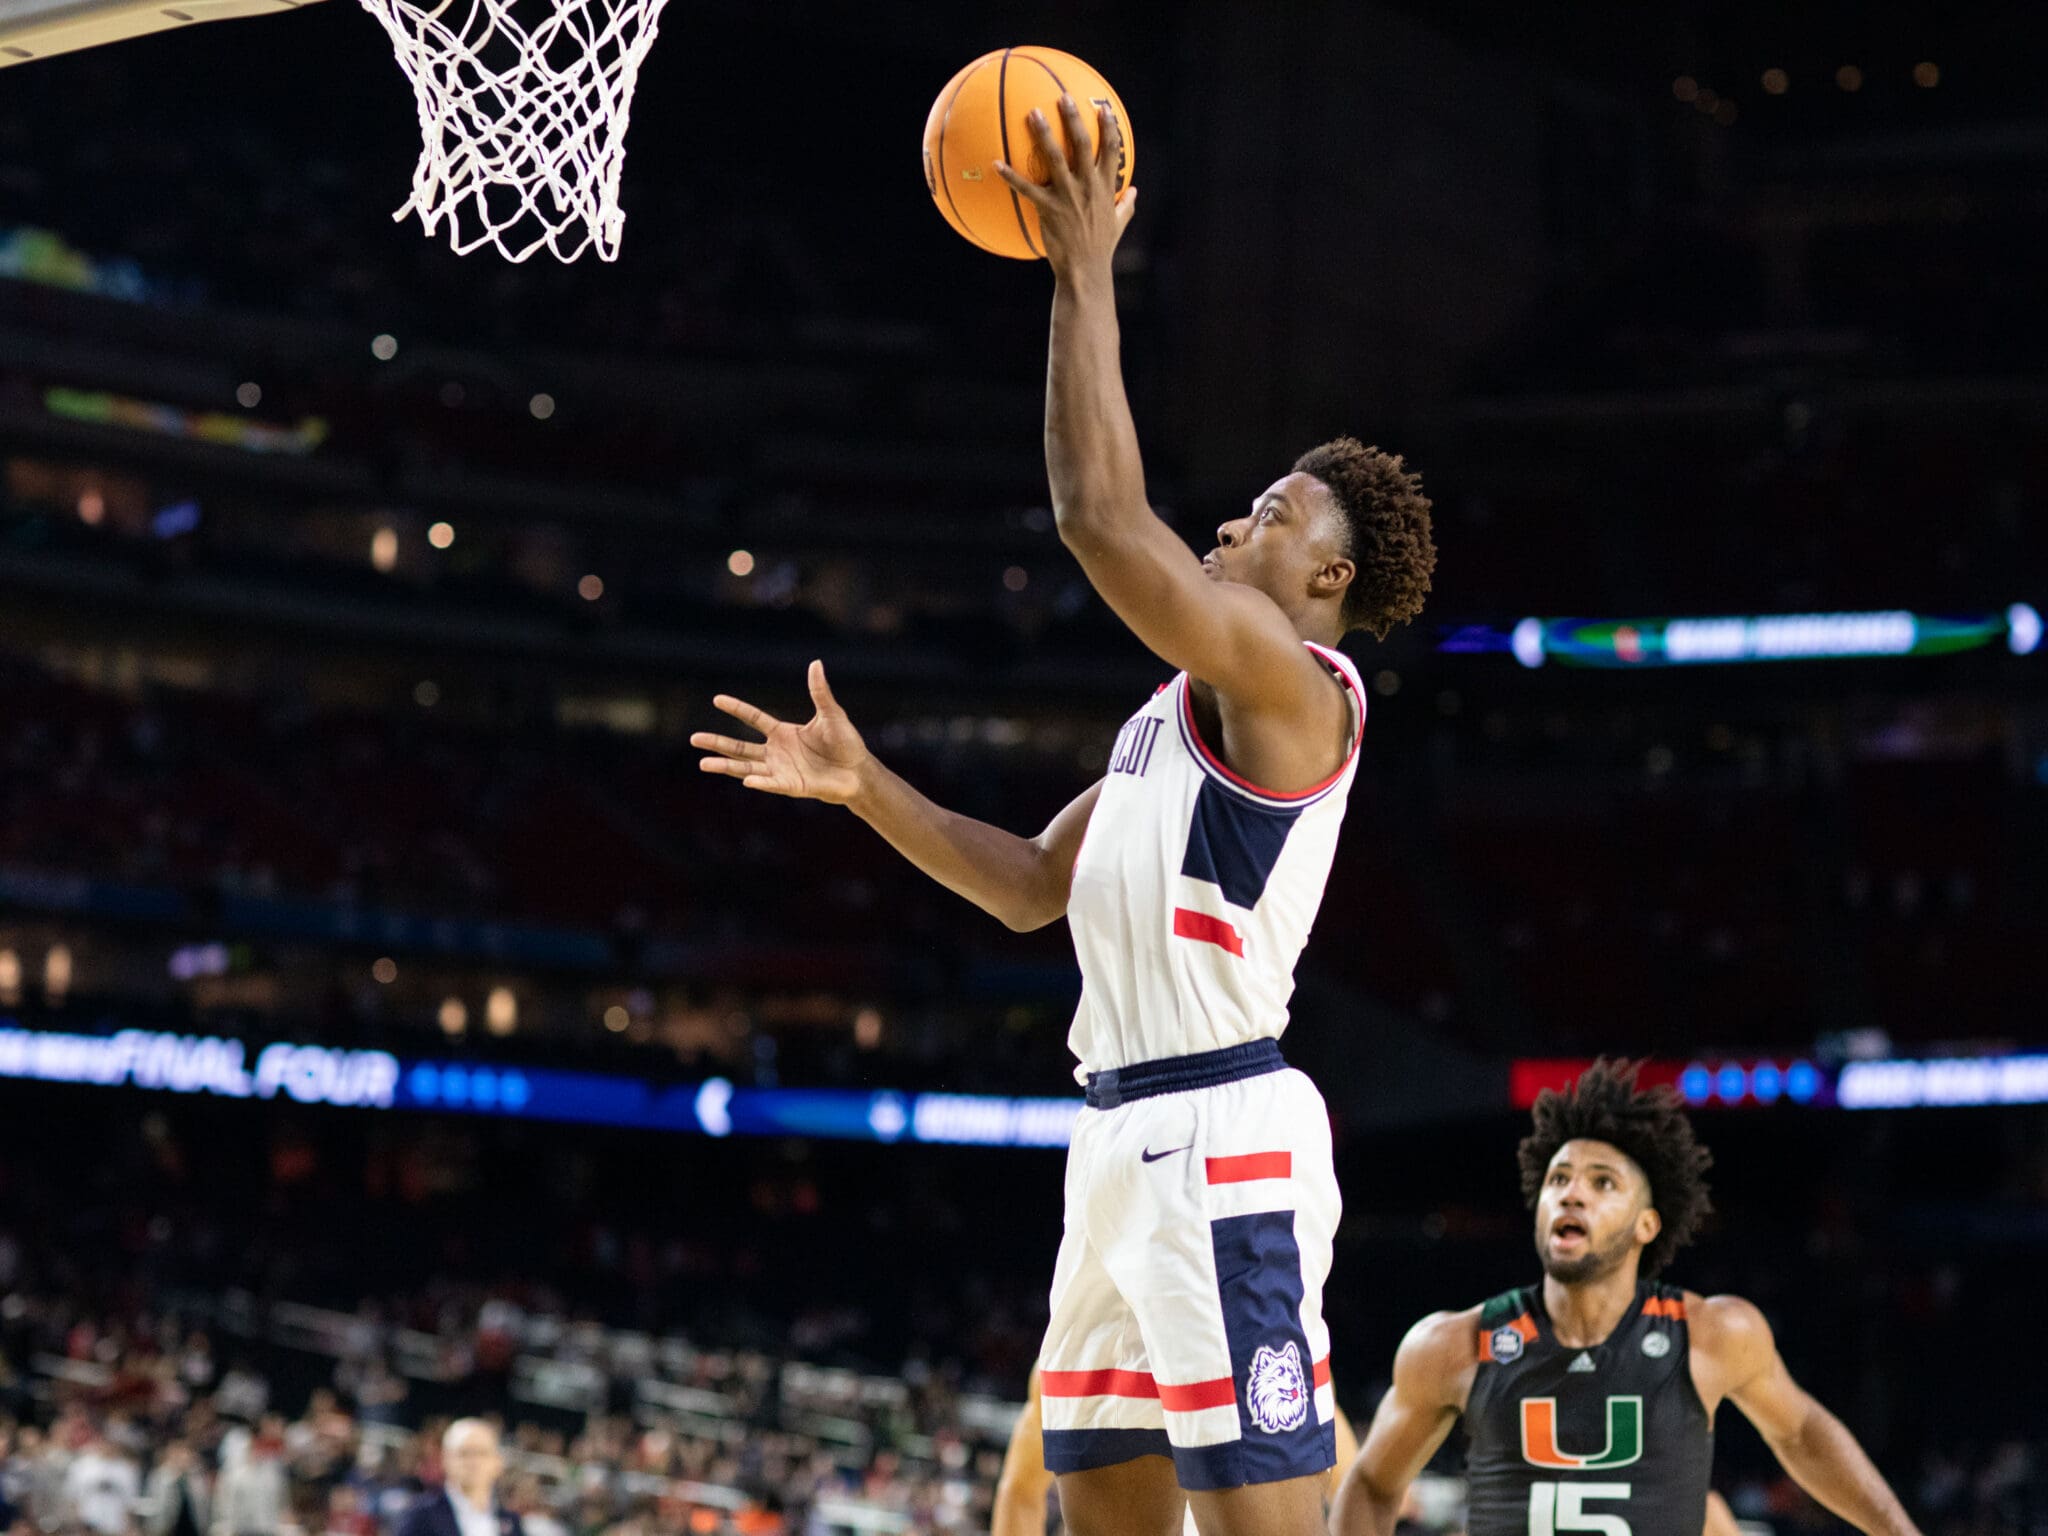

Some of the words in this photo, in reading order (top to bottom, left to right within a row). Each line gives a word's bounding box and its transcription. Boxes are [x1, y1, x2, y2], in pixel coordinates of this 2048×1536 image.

[110, 1028, 252, 1097] FINAL
[255, 1042, 399, 1108] FOUR
[1520, 1395, 1643, 1469] U
[1528, 1481, 1632, 1536] 15
